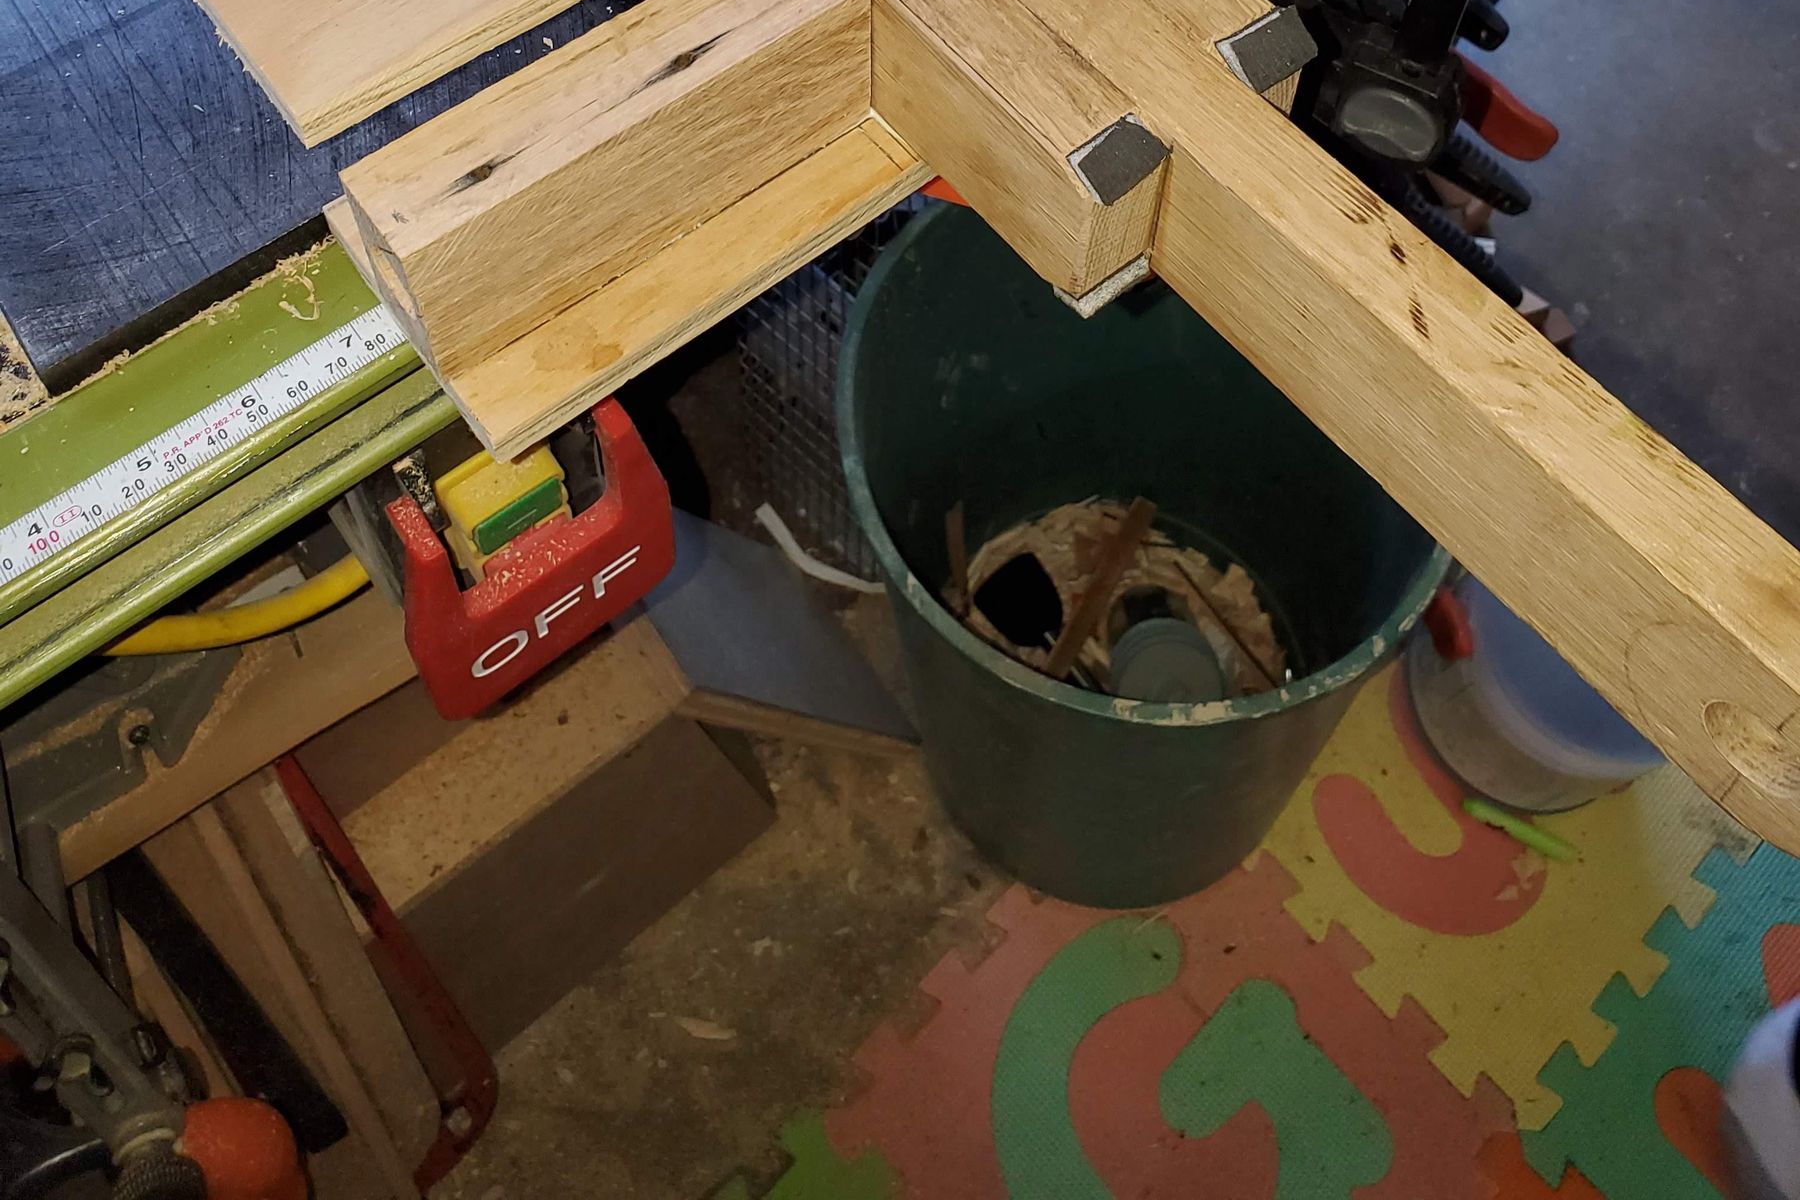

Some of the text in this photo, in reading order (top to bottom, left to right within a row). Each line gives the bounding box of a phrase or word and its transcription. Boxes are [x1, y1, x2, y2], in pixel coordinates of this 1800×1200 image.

[338, 334, 353, 348] 7
[364, 333, 386, 351] 80
[324, 356, 348, 375] 70
[286, 380, 308, 399] 60
[241, 394, 256, 408] 6
[246, 404, 269, 423] 50
[207, 428, 228, 446] 40
[136, 456, 152, 472] 5
[164, 453, 187, 473] 30
[121, 478, 145, 499] 20
[80, 504, 102, 523] 10
[27, 522, 43, 538] 4
[28, 530, 60, 555] 100
[471, 544, 641, 678] OFF
